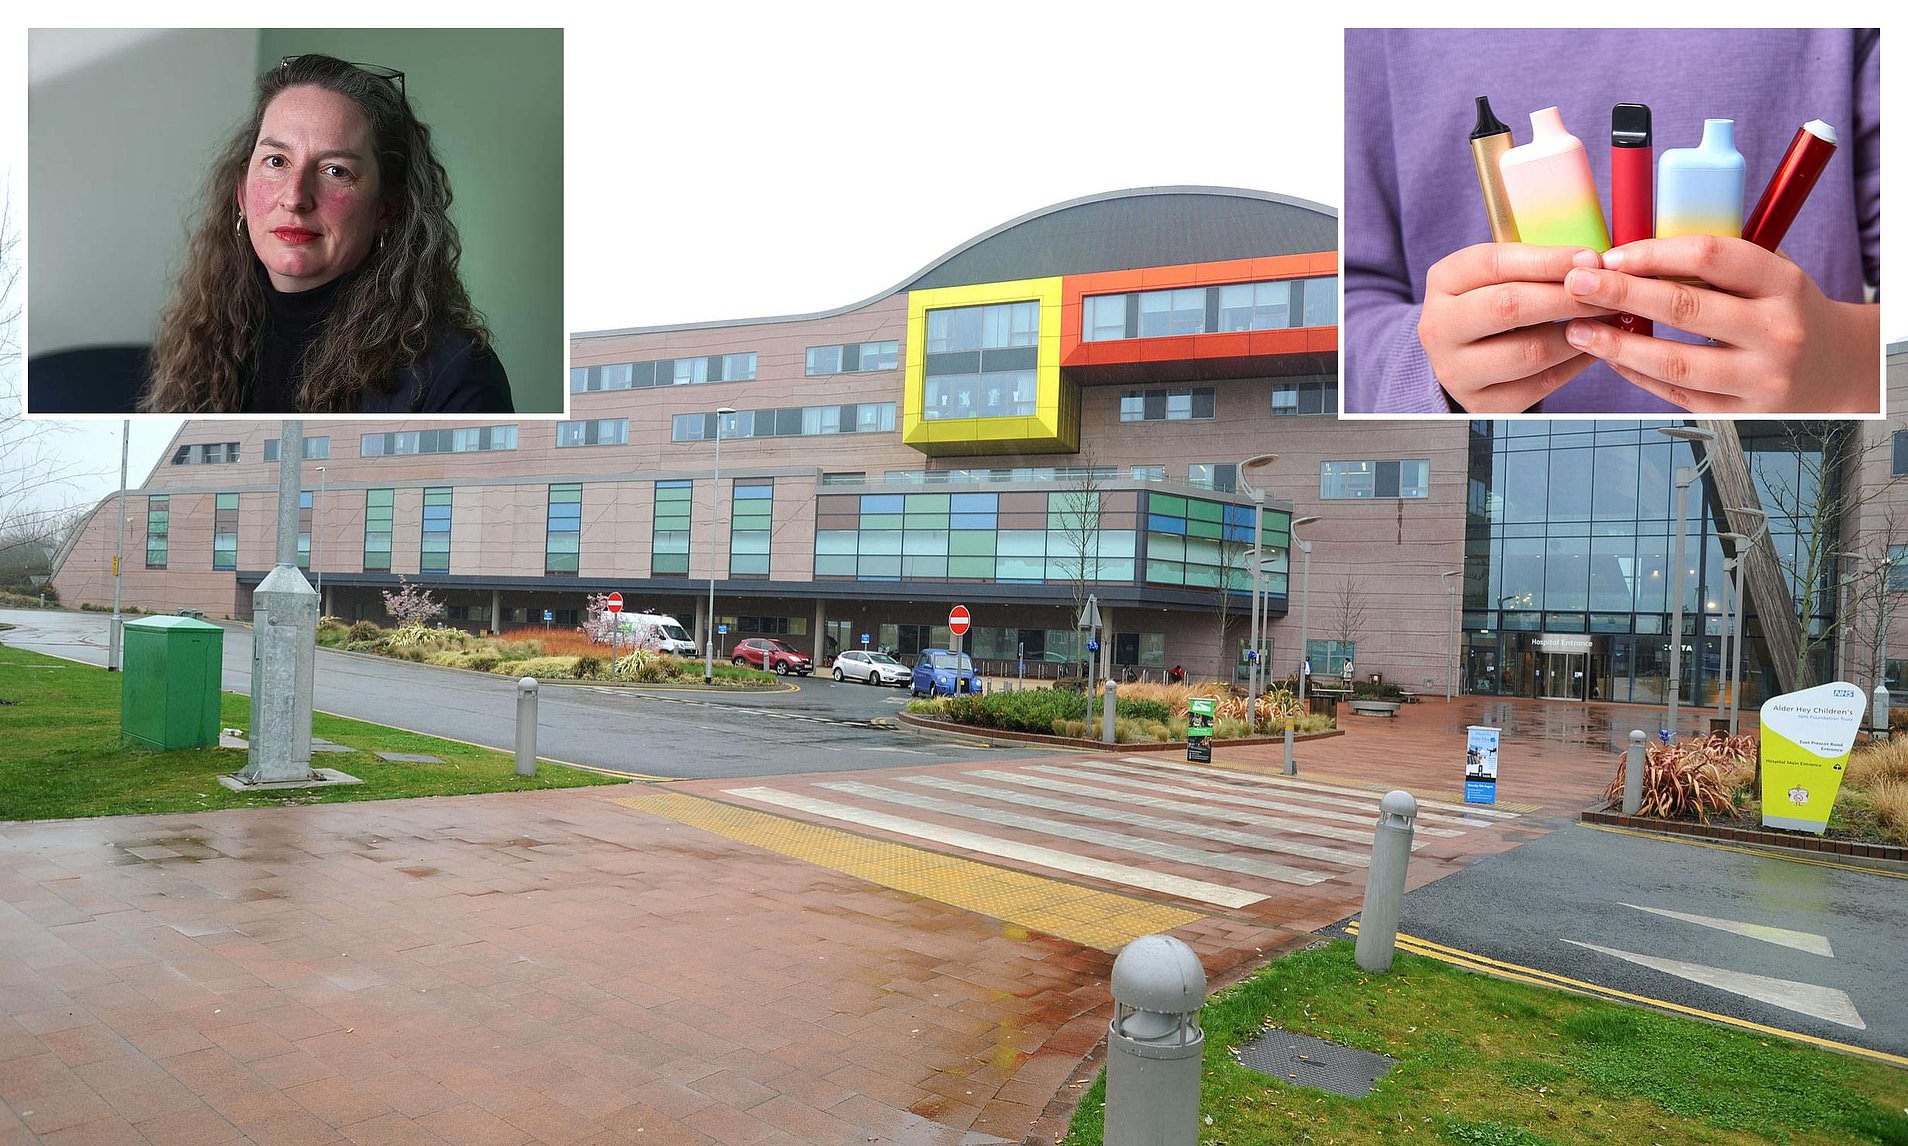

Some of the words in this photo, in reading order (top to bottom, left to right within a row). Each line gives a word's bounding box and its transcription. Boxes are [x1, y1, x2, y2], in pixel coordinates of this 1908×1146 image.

[1531, 638, 1560, 647] Hospital
[1561, 639, 1593, 647] Entrance
[1833, 689, 1855, 698] NHS
[1773, 704, 1794, 712] Alder
[1796, 706, 1811, 714] Hey
[1813, 707, 1853, 715] Children's
